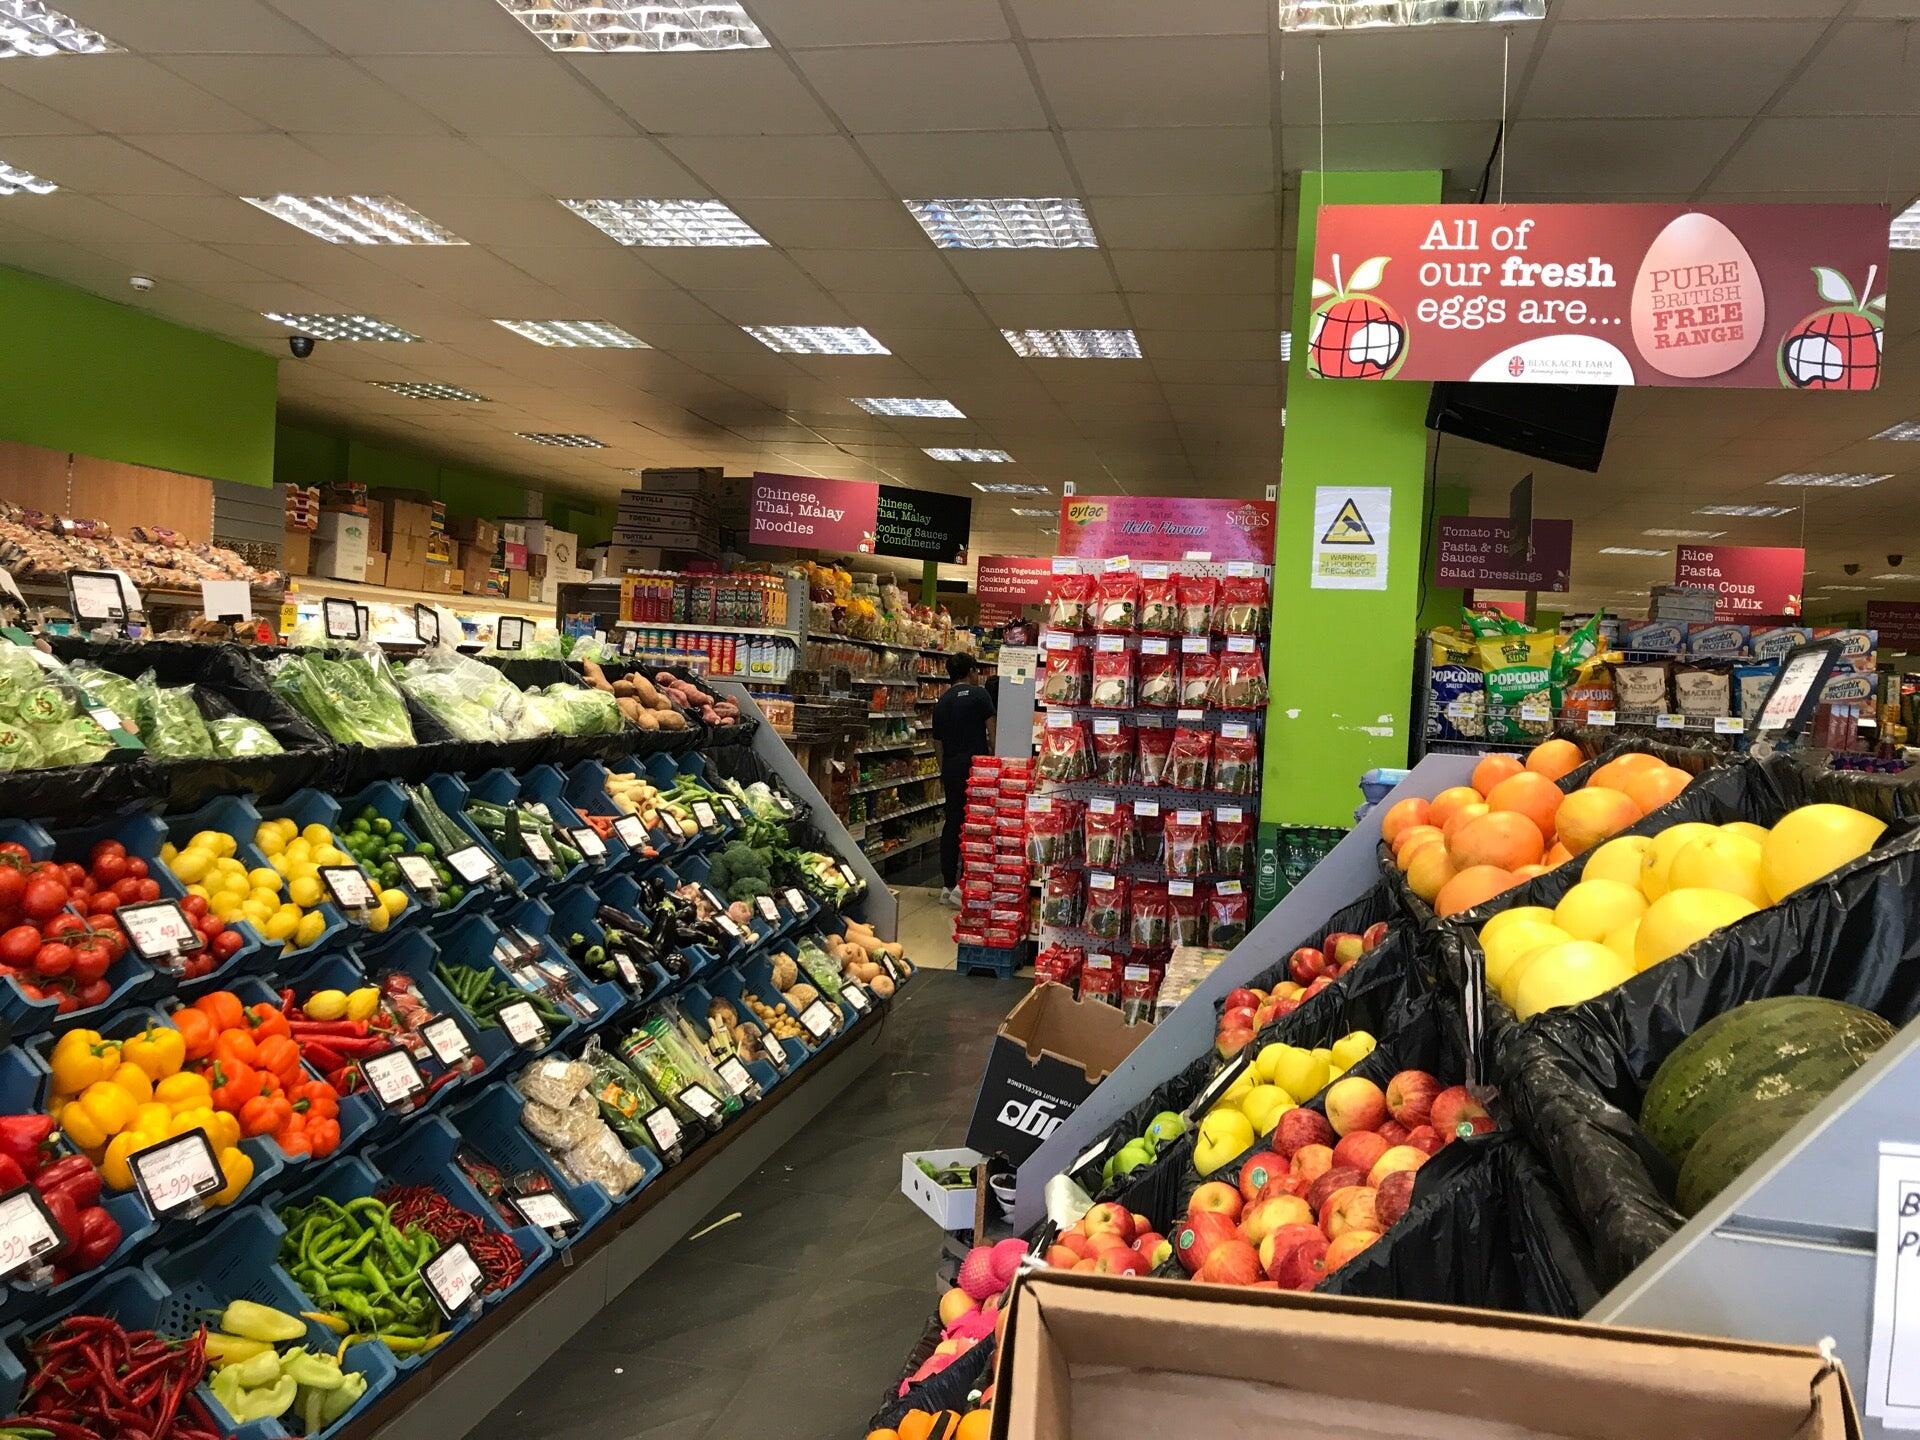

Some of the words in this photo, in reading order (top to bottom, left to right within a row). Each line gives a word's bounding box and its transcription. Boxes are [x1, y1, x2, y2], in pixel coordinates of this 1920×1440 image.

[1420, 220, 1479, 250] All
[1491, 219, 1535, 250] of
[1419, 262, 1491, 287] our
[1500, 256, 1617, 287] fresh
[1650, 261, 1740, 292] PURE
[1652, 286, 1742, 310] BRITISH
[1417, 295, 1507, 330] eggs
[1518, 299, 1621, 325] are...
[1653, 302, 1743, 331] FREE
[1655, 325, 1744, 349] RANGE
[1585, 360, 1613, 369] FARM
[757, 486, 820, 506] Chinese,
[756, 500, 794, 517] Thai,
[799, 505, 844, 522] Malay
[901, 510, 932, 526] Malay
[1070, 504, 1104, 519] aytac
[754, 518, 814, 535] Noodles
[1225, 511, 1270, 527] SPICES
[914, 527, 948, 541] Sauces
[1121, 519, 1155, 534] Hello
[1156, 520, 1208, 536] Flavour
[1443, 526, 1490, 538] Tomato
[882, 534, 941, 550] Condiments
[1442, 541, 1477, 553] Pasta
[1480, 543, 1491, 553] &
[1441, 552, 1486, 564] Sauces
[1681, 549, 1714, 562] Rice
[980, 566, 1009, 575] Canned
[1010, 567, 1051, 576] Vegetables
[1325, 567, 1370, 576] RECORDING
[1440, 567, 1476, 578] Salad
[1479, 568, 1543, 583] Dressings
[1679, 565, 1722, 578] Pasta
[980, 576, 1011, 585] Cooking
[1011, 577, 1039, 585] Sauces
[1719, 582, 1755, 594] Cous
[980, 585, 1008, 593] Canned
[1009, 586, 1026, 594] Fish
[1732, 598, 1763, 610] Mix
[1841, 644, 1865, 654] TEIN
[1508, 654, 1526, 662] SUN
[1431, 670, 1484, 684] POPCORN
[1489, 670, 1549, 686] POPCORN
[1824, 688, 1865, 700] PROTEIN
[1006, 1077, 1043, 1097] EXCELLENCE
[1042, 1093, 1060, 1104] FRUIT
[1898, 1230, 1920, 1257] P
